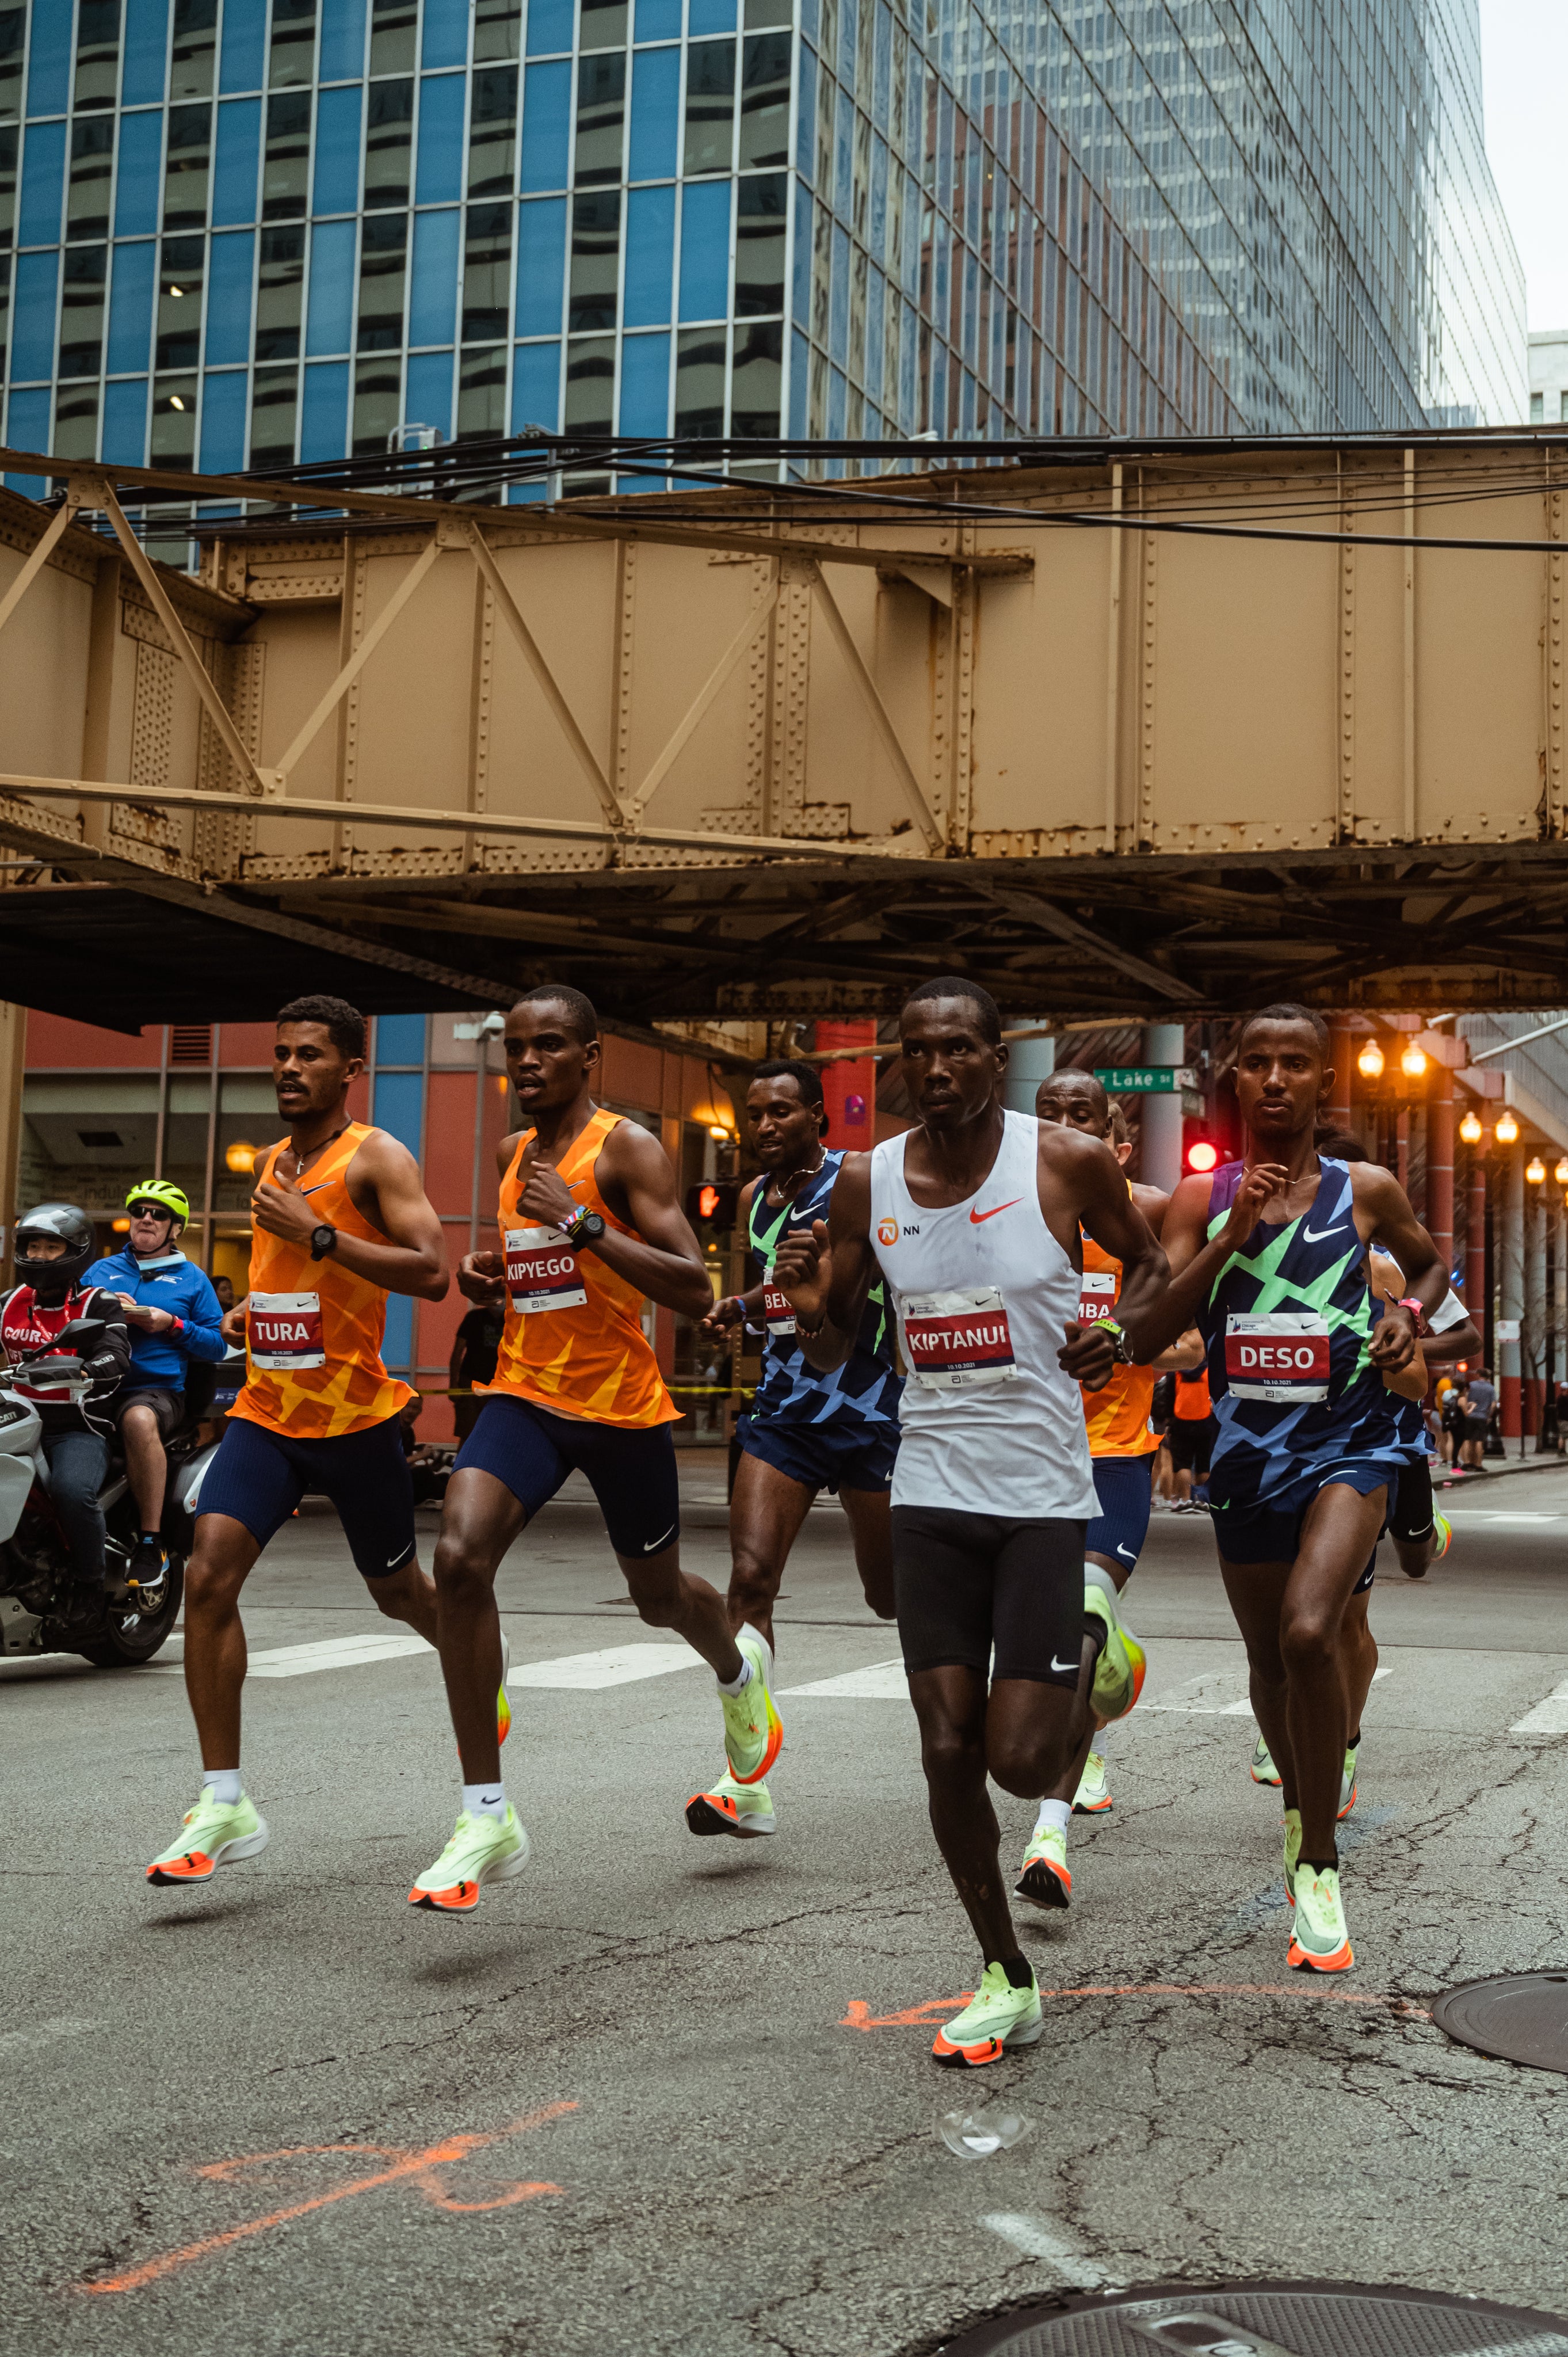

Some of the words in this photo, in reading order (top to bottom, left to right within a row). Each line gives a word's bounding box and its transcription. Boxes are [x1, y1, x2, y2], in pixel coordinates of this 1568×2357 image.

[1112, 1071, 1153, 1087] Lake
[903, 1225, 920, 1236] NN
[507, 1256, 575, 1281] KIPYEGO
[5, 1326, 58, 1344] COURS
[255, 1322, 310, 1341] TURA
[909, 1325, 1006, 1351] KIPTANUI
[947, 1362, 975, 1370] 10.10.2021
[1240, 1346, 1314, 1369] DESO
